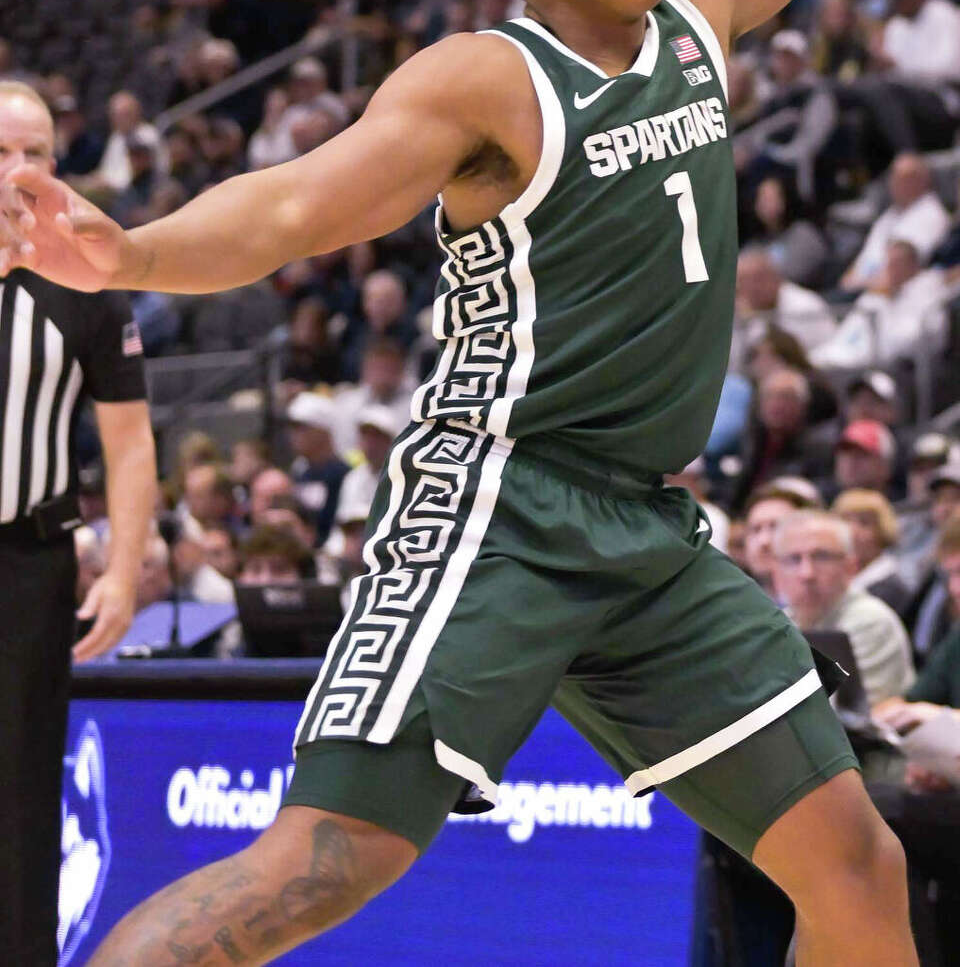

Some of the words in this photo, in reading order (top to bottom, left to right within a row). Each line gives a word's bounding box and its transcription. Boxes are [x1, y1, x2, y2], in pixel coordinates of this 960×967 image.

[583, 97, 728, 178] SPARTANS
[663, 171, 710, 284] 1
[166, 764, 284, 830] Official
